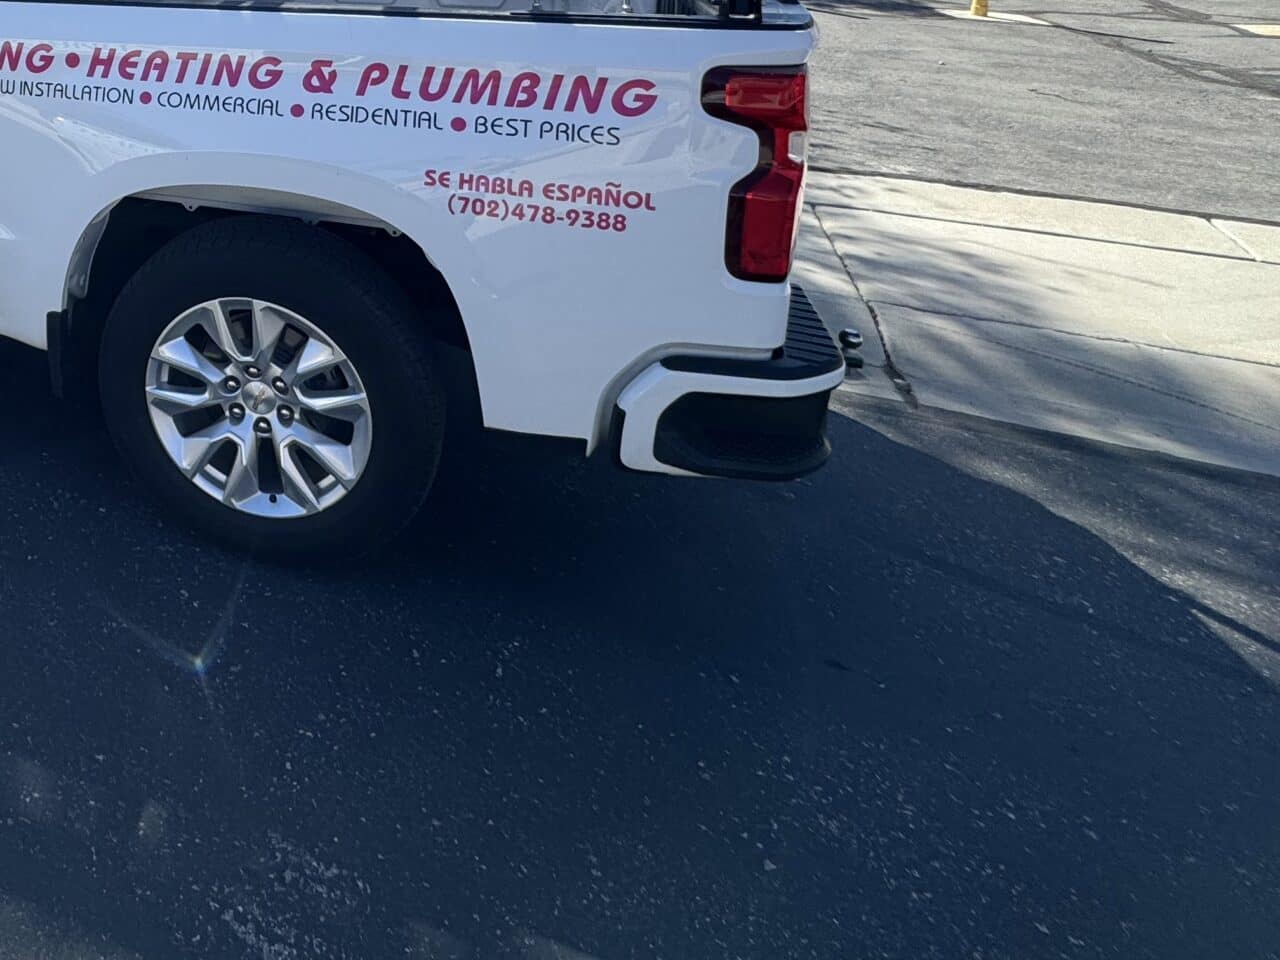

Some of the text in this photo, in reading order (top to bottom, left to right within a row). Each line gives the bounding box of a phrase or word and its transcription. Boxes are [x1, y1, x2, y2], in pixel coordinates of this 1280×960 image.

[86, 46, 283, 90] HEATING
[302, 59, 337, 95] &
[355, 62, 658, 118] PLUMBING
[19, 81, 134, 105] INSTALLATION
[157, 92, 284, 117] COMMERCIAL
[311, 104, 443, 131] RESIDENTIAL
[475, 115, 532, 138] BEST
[539, 120, 621, 146] PRICES
[423, 168, 657, 211] SE HABLA ESPAÑOL
[447, 193, 628, 233] (702)478-9388
